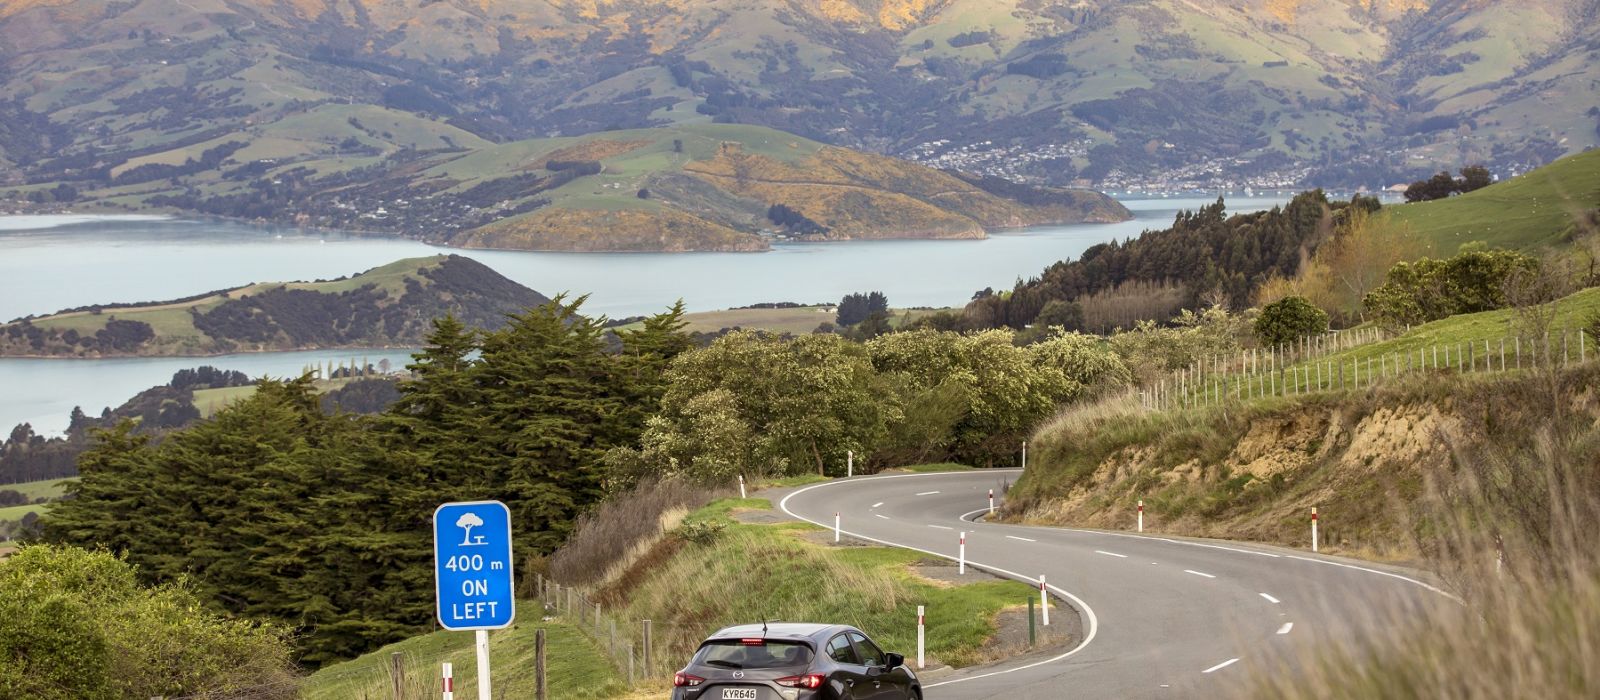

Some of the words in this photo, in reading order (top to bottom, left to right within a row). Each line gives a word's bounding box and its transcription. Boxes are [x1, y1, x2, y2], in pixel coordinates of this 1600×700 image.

[445, 555, 483, 572] 400
[491, 561, 503, 570] m
[462, 580, 488, 597] ON
[453, 602, 498, 620] LEFT
[723, 689, 755, 699] KYR646
